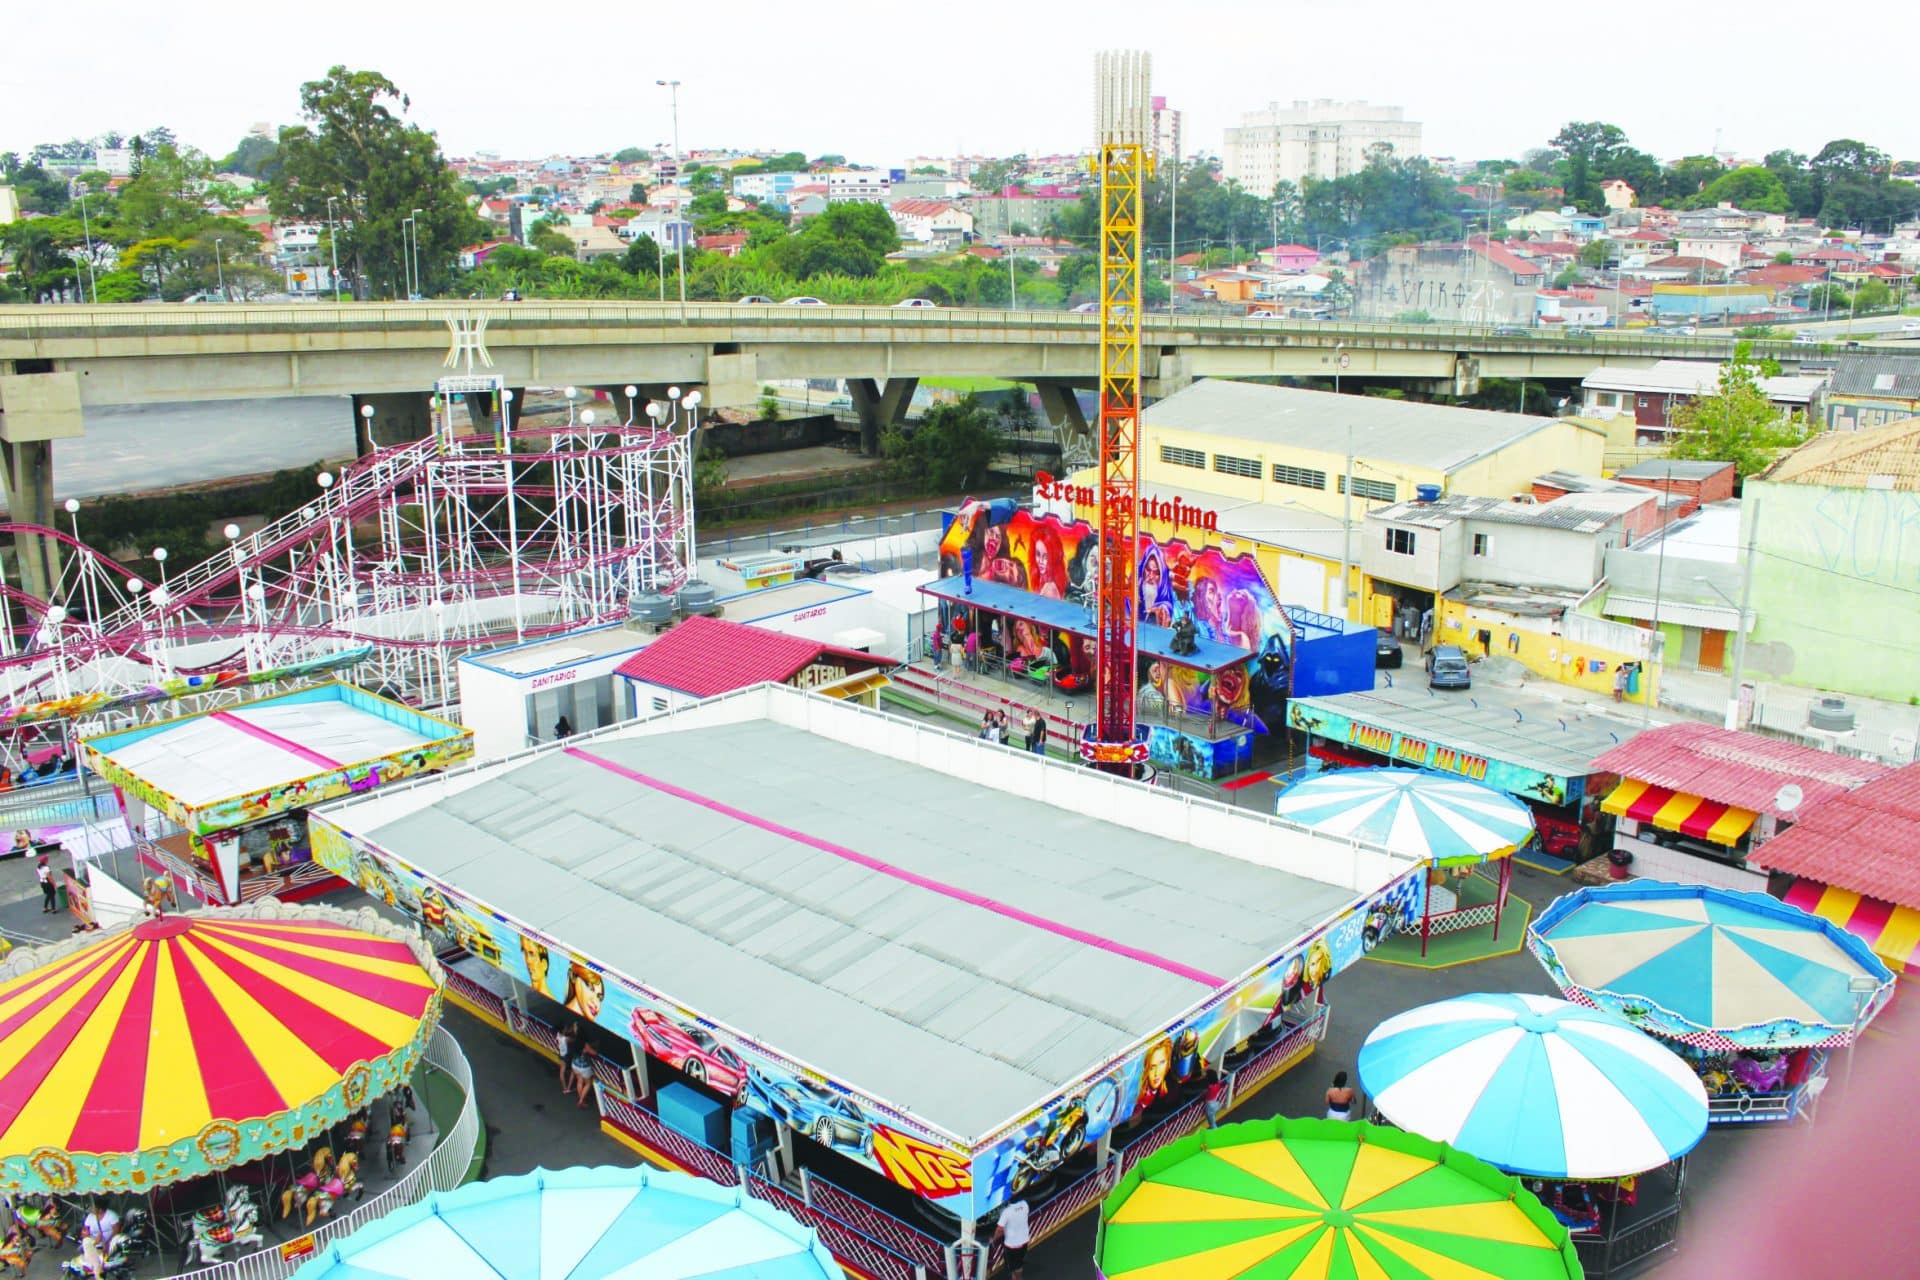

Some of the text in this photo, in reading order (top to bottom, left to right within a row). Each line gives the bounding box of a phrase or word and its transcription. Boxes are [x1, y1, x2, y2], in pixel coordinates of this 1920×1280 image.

[1035, 470, 1094, 508] Trem
[1348, 722, 1393, 754] TIRO
[1433, 746, 1487, 781] ALVO
[868, 1122, 972, 1200] NOS
